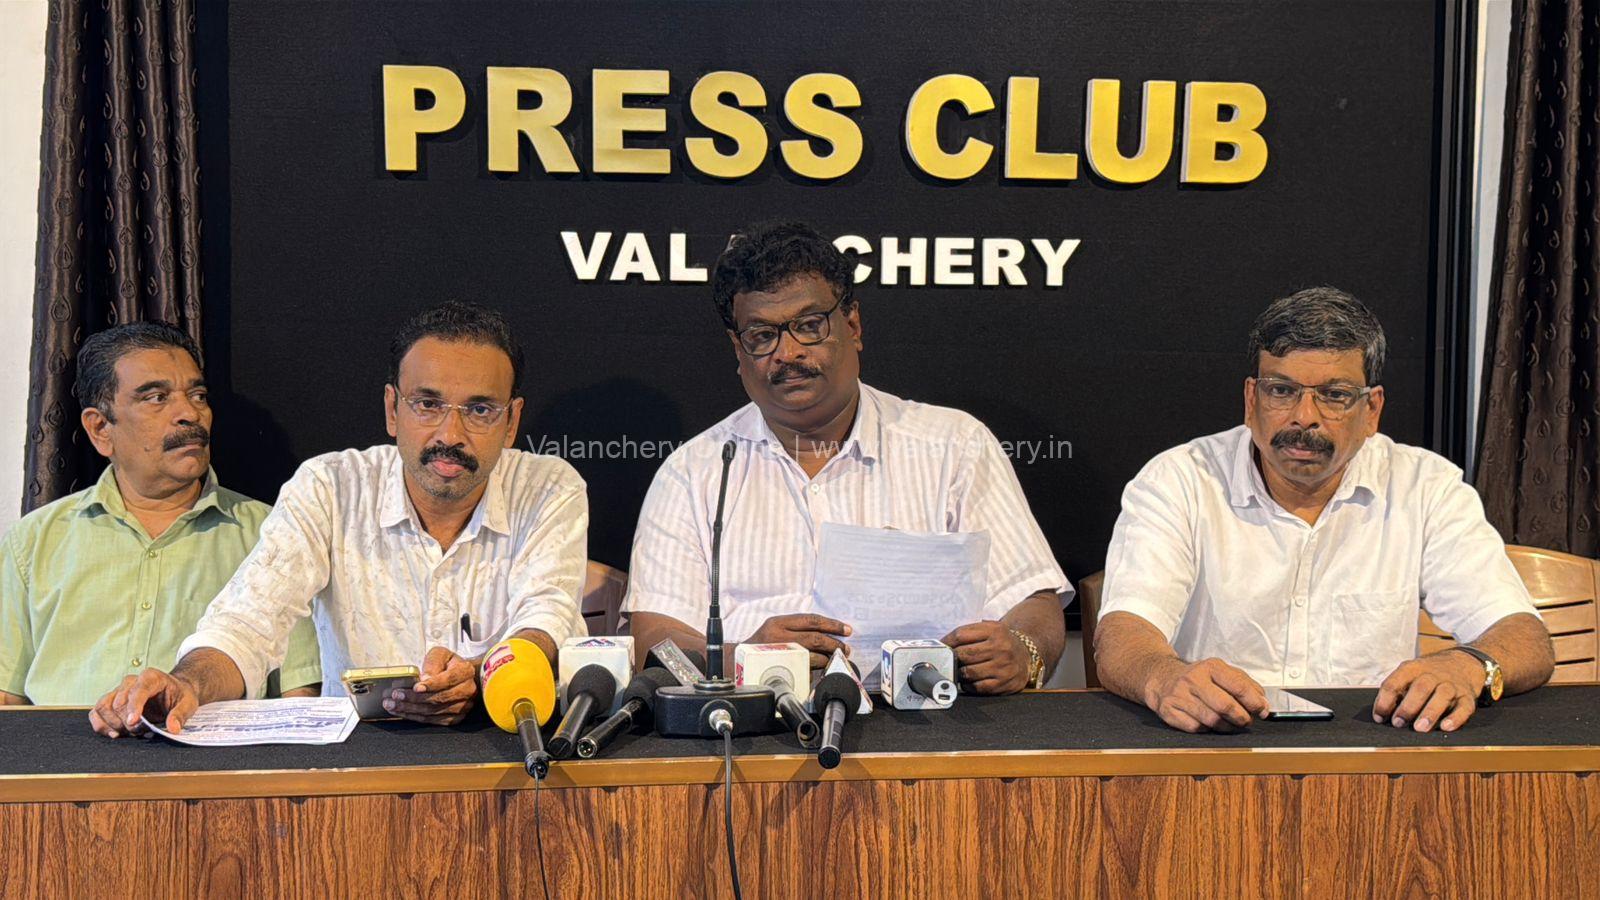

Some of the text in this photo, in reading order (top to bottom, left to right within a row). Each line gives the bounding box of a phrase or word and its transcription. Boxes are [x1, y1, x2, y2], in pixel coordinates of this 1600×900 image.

[383, 65, 1269, 184] PRESS CLUB
[560, 231, 1081, 286] VALCHERY
